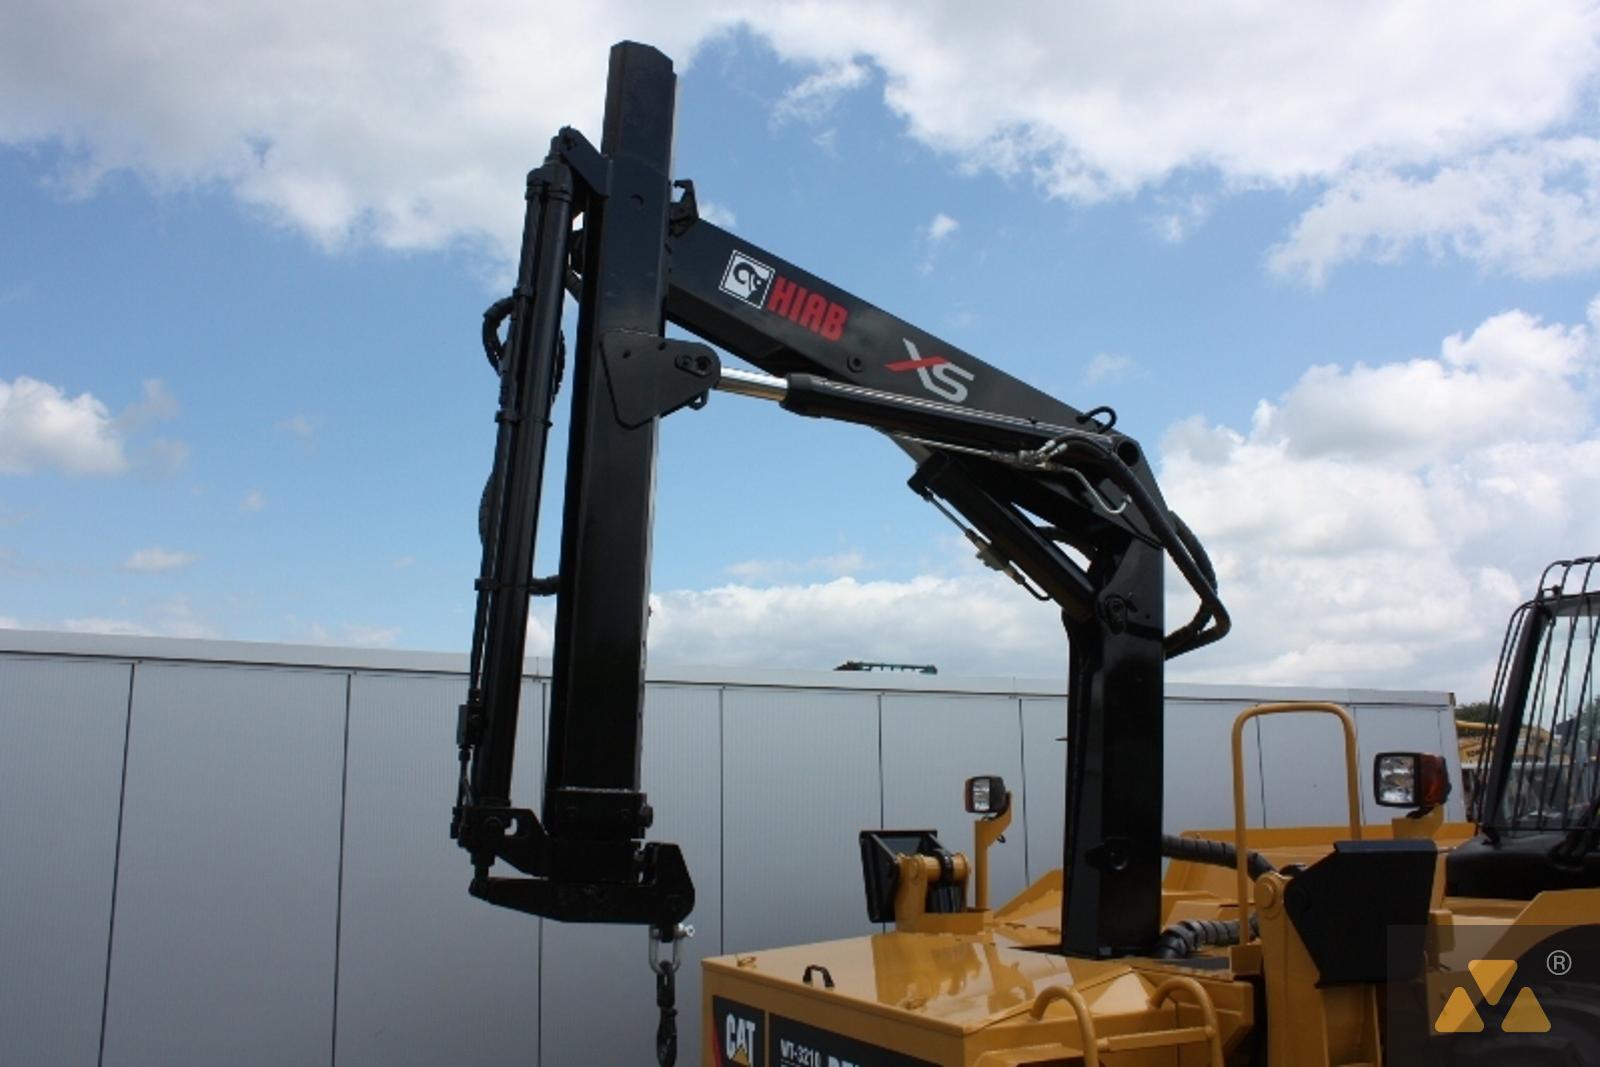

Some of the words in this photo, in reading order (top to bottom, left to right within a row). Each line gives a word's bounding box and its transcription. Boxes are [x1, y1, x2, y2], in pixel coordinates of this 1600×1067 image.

[767, 276, 849, 342] HIAB
[885, 337, 975, 403] XS
[726, 1013, 756, 1067] CAT
